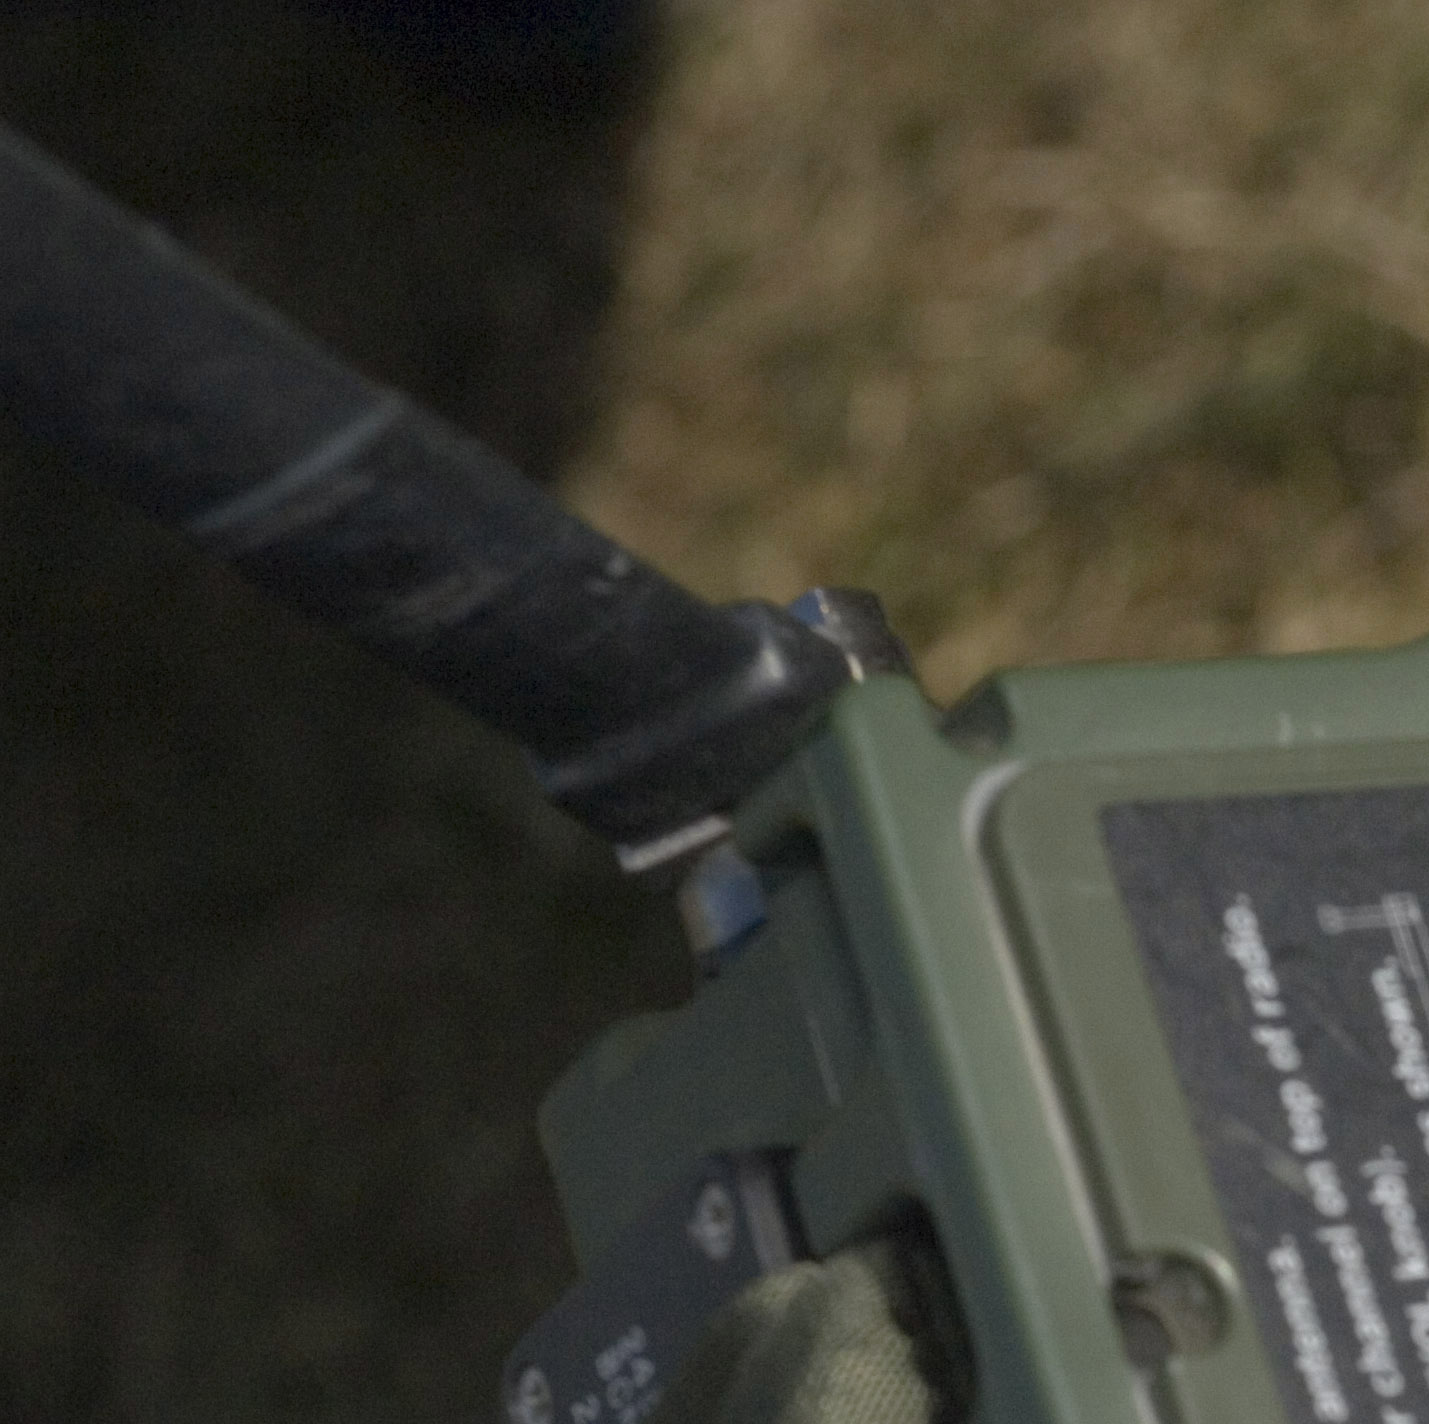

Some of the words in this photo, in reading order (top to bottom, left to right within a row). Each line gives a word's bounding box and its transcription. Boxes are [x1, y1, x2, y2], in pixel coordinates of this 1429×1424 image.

[1223, 893, 1285, 1018] radio.
[1251, 1025, 1301, 1072] of
[1279, 1078, 1328, 1155] top
[1299, 1159, 1349, 1218] on
[1267, 1235, 1350, 1424] antenna.
[1315, 1224, 1405, 1398] channel
